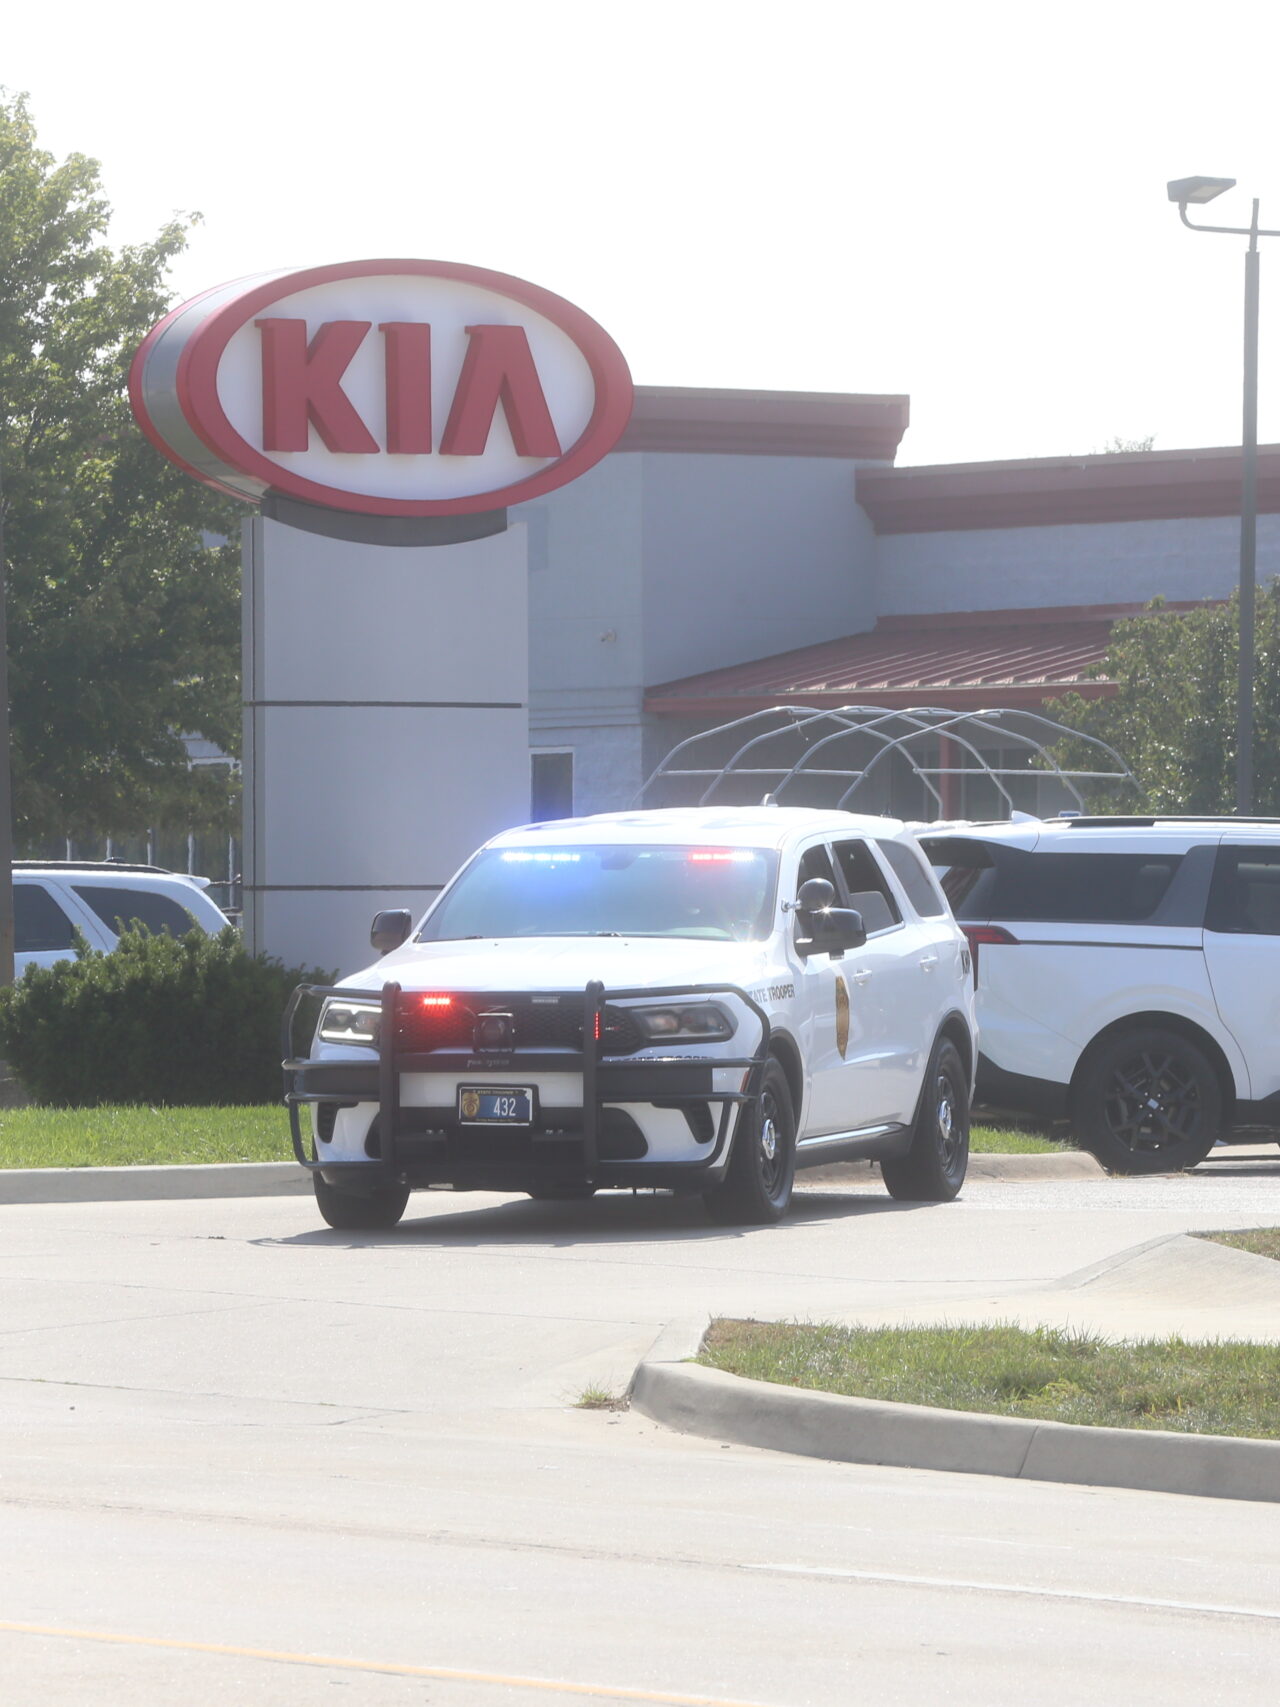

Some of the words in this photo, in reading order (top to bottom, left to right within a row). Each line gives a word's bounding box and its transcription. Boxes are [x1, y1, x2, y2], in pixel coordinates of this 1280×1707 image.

[255, 318, 562, 458] KIA
[767, 984, 796, 1001] TROOPER
[493, 1097, 517, 1117] 432
